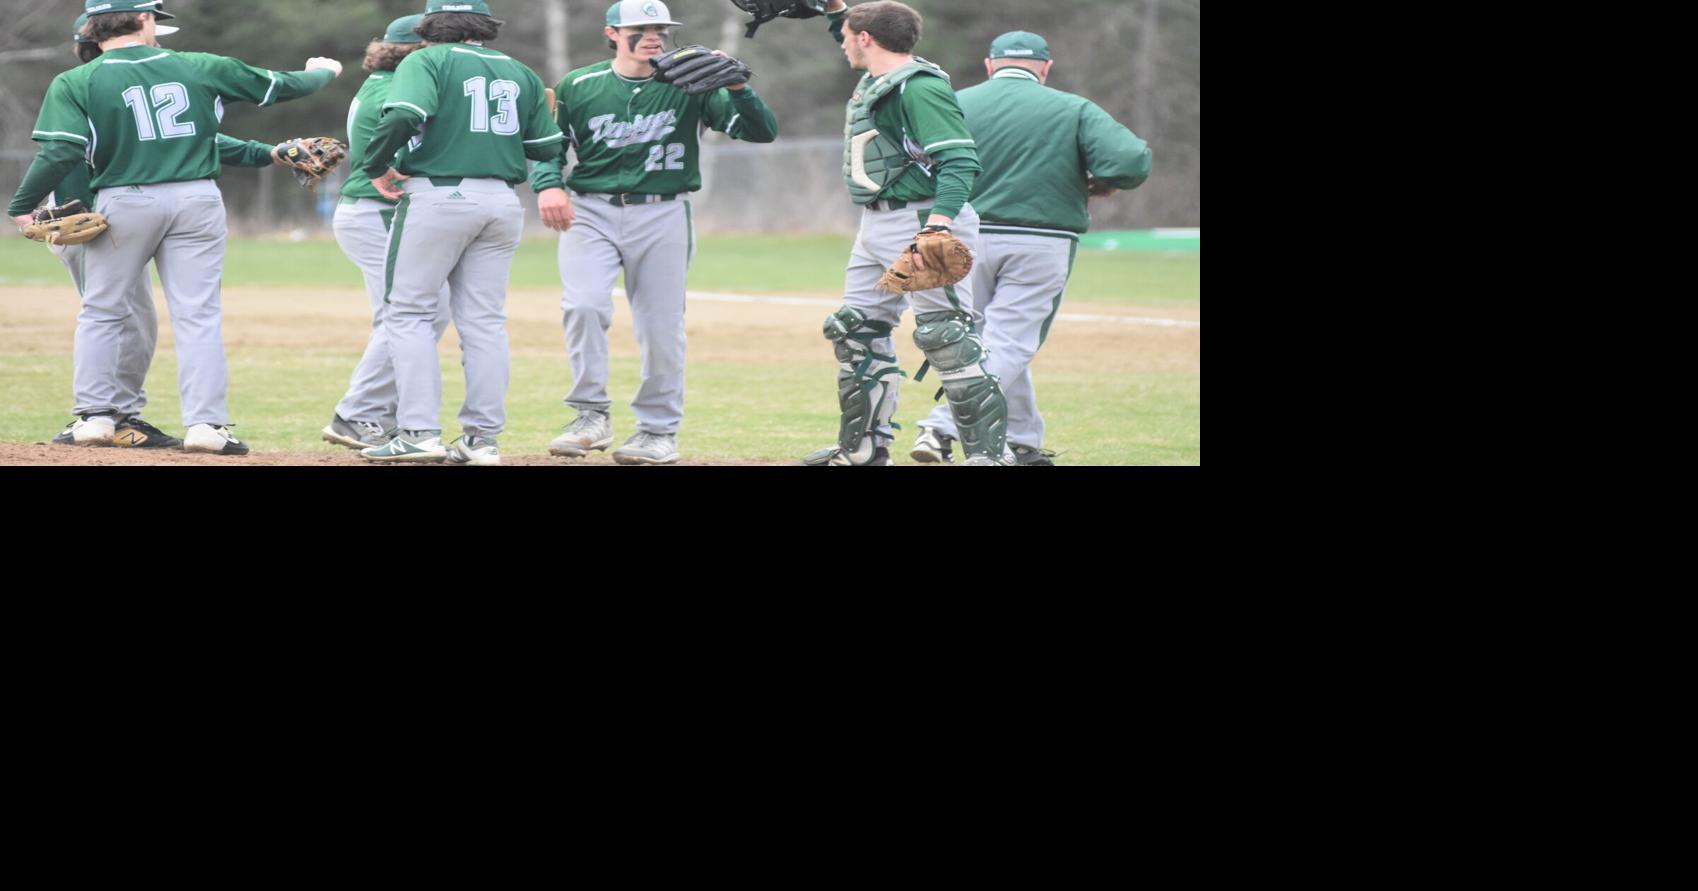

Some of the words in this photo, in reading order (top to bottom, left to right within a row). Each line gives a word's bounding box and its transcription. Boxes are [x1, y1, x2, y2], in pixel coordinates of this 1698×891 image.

[121, 82, 196, 141] 12
[463, 75, 520, 136] 13
[644, 142, 685, 171] 22
